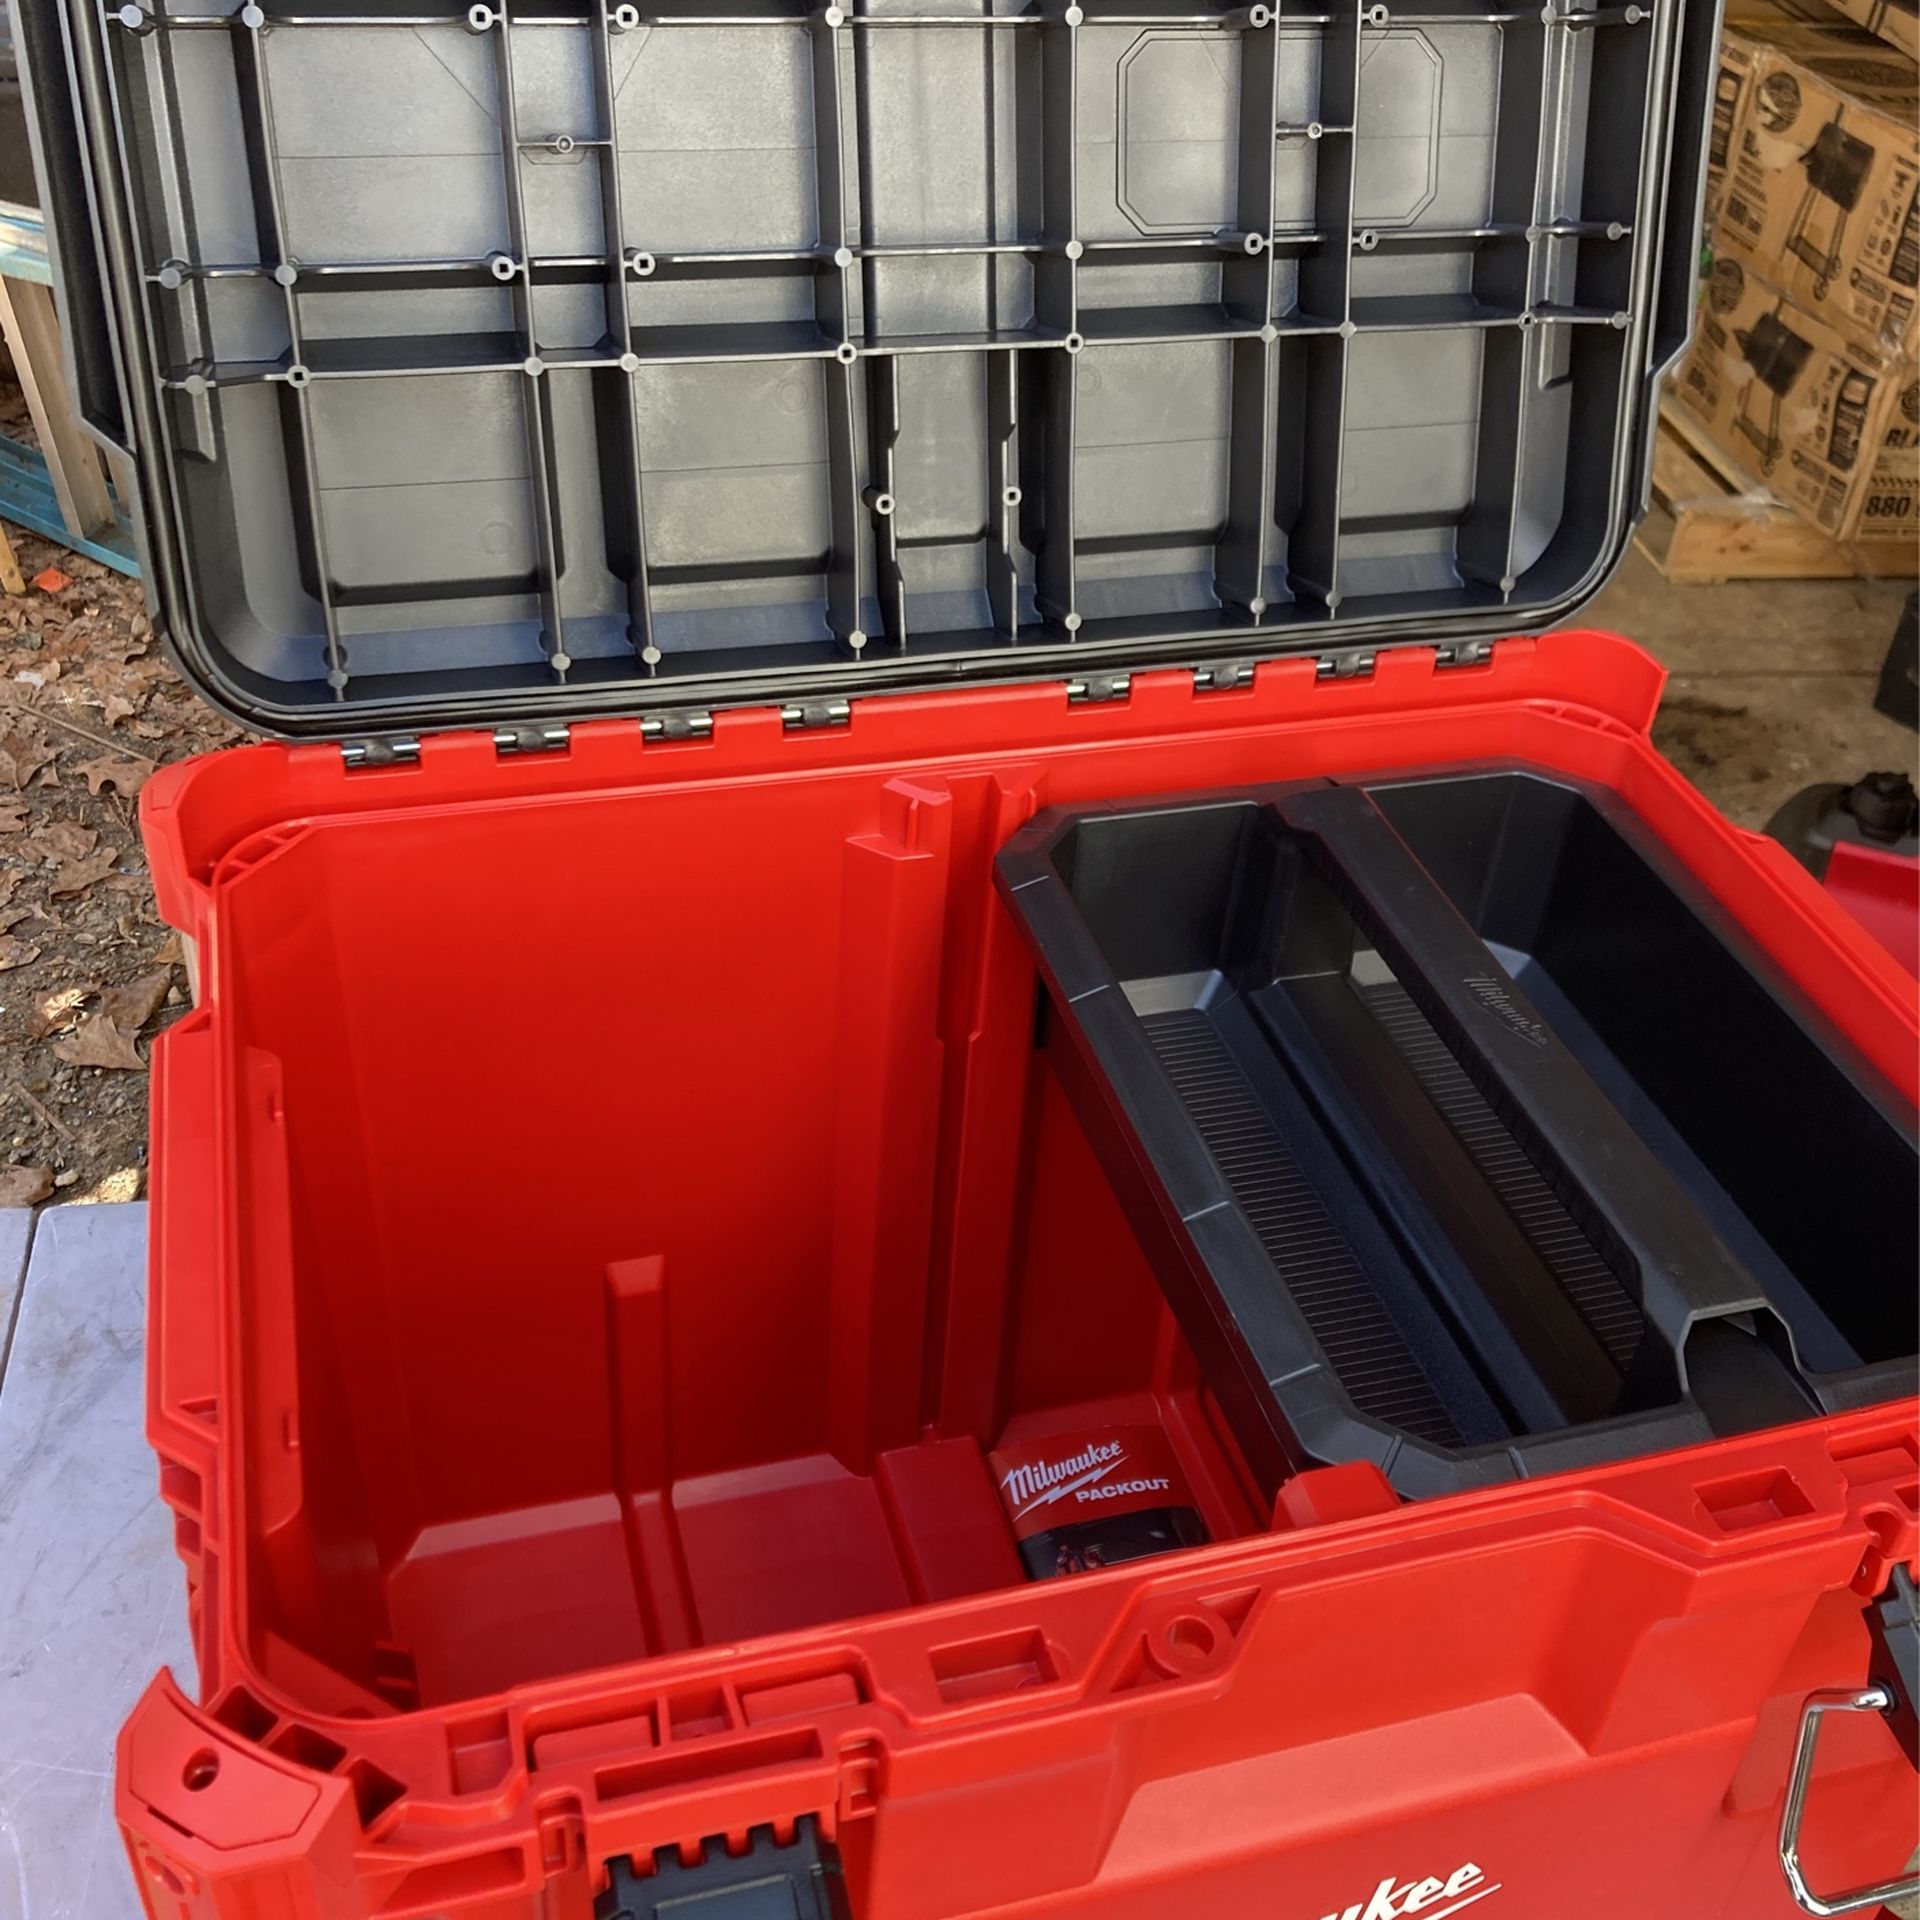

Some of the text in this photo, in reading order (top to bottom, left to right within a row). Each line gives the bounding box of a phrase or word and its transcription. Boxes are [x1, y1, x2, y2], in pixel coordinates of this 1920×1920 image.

[1865, 495, 1911, 518] 880
[1463, 971, 1548, 1045] Milwaukee
[1000, 1440, 1124, 1506] Milwaukee
[1075, 1478, 1169, 1503] PACKOUT
